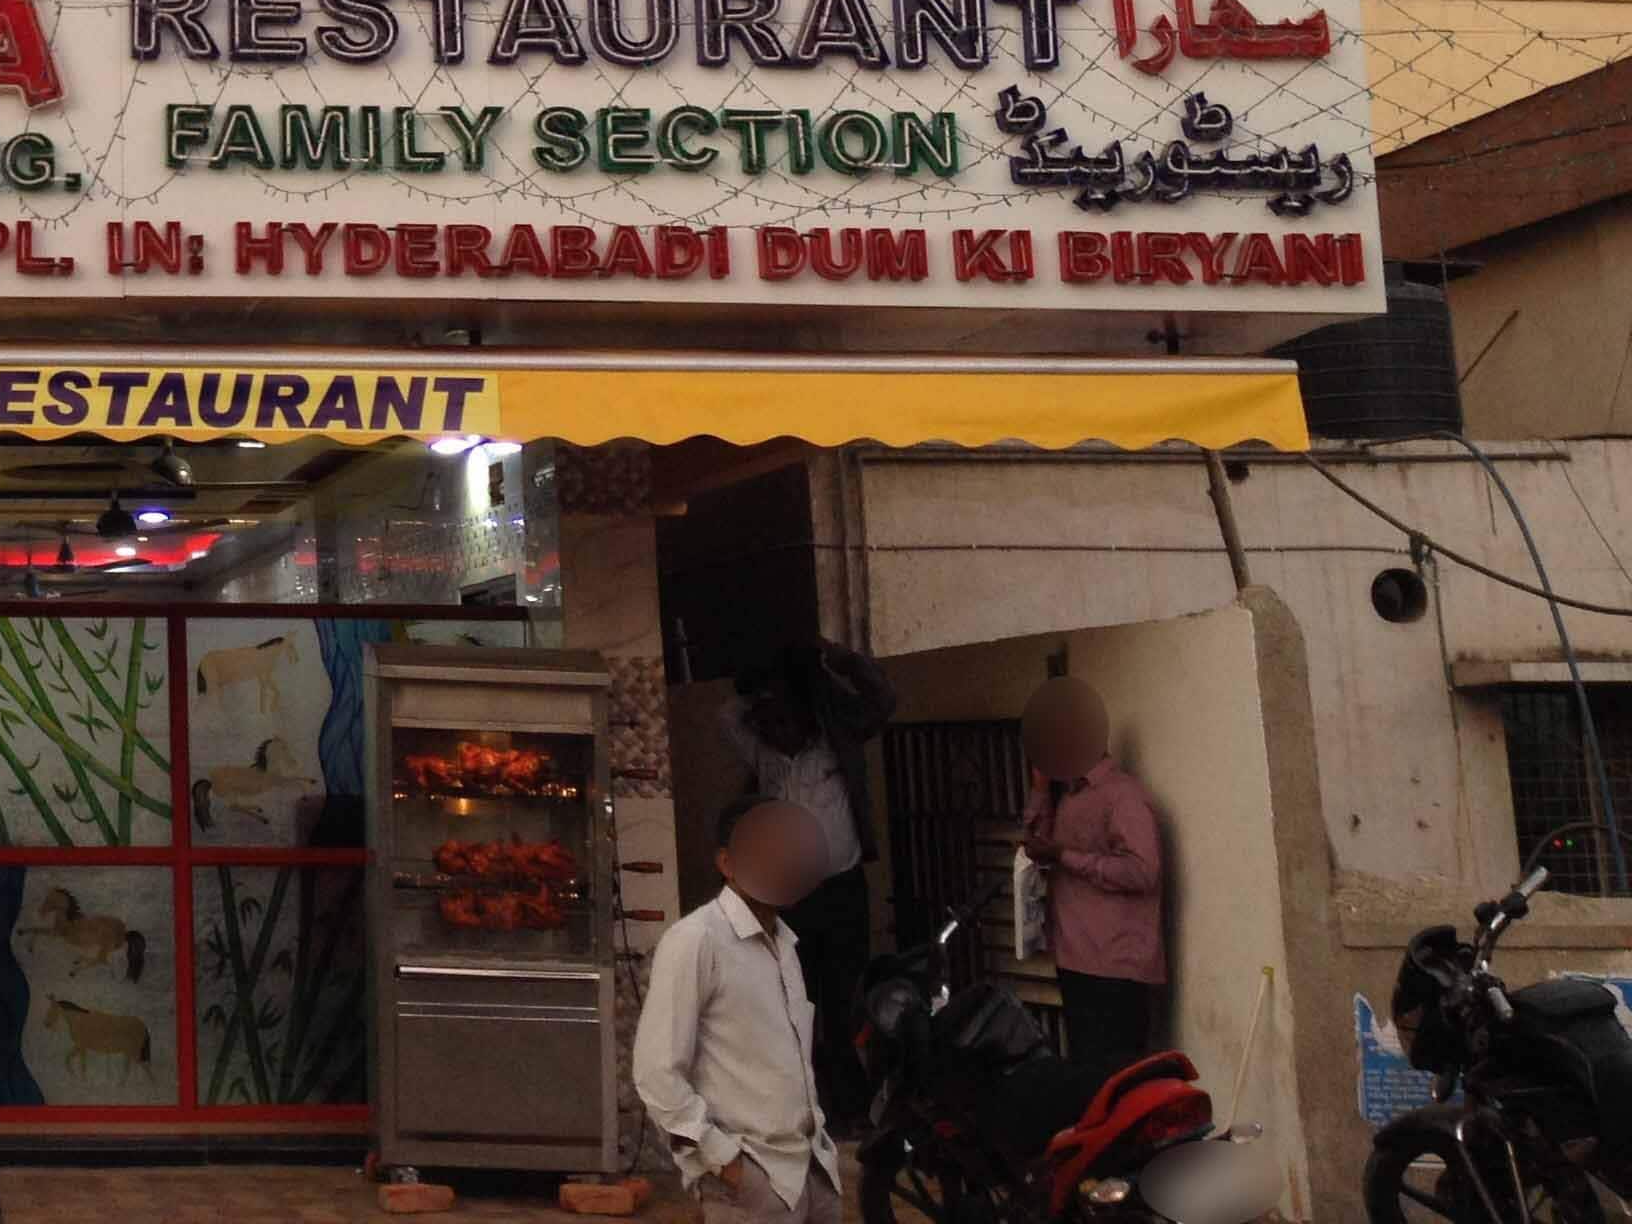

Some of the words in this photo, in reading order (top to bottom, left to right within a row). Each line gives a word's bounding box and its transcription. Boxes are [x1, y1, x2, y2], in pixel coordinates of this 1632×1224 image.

[165, 103, 504, 172] FAMILY
[532, 105, 959, 176] SECTION
[106, 220, 205, 275] IN:
[234, 221, 731, 279] HYDERABADI
[757, 226, 929, 282] DUM
[953, 228, 1035, 283] KI
[1059, 230, 1366, 286] BIRYANI
